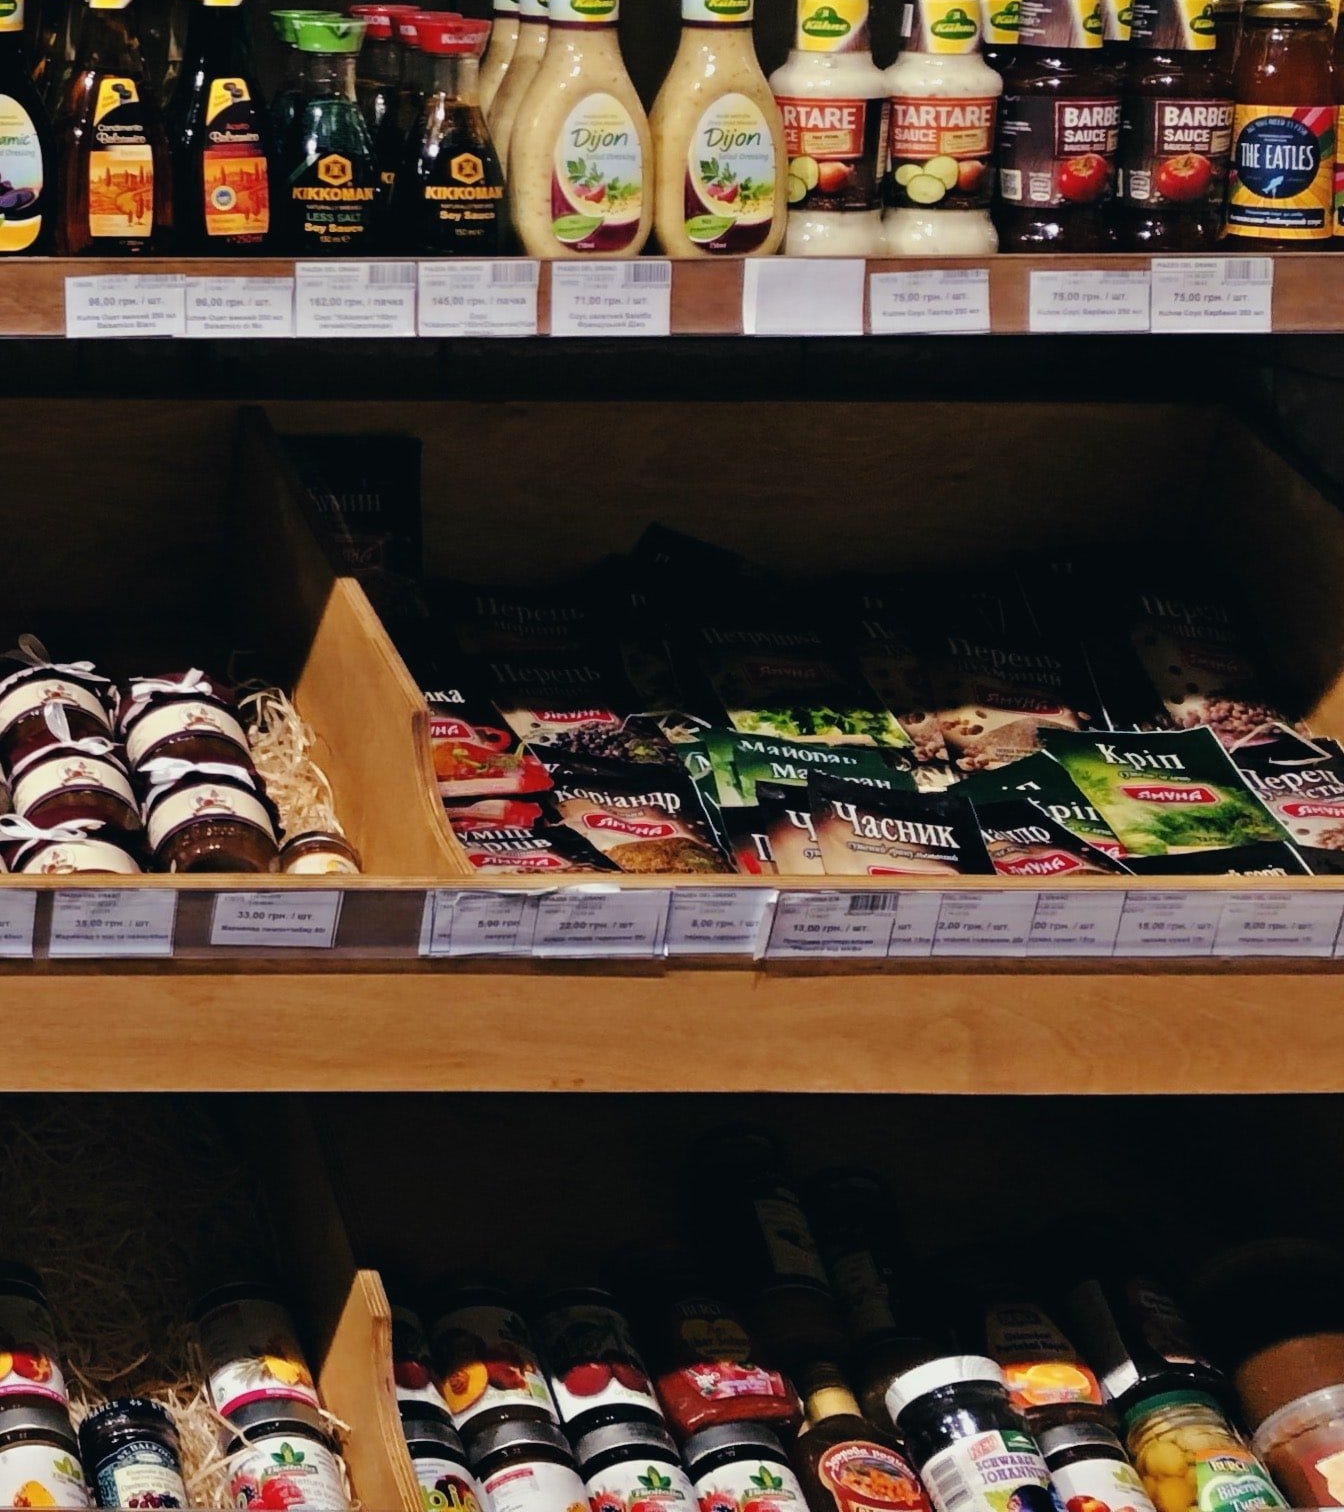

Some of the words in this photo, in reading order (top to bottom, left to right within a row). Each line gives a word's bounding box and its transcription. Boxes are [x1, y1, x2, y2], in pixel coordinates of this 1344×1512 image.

[895, 106, 991, 128] TARTARE
[571, 128, 627, 151] Dijon
[704, 128, 761, 151] Dijon
[895, 130, 936, 143] SAUCE
[1065, 130, 1105, 142] SAUCE
[1164, 130, 1210, 142] SAUCE
[1241, 142, 1260, 168] THE
[1267, 143, 1313, 170] EATLES
[293, 187, 373, 201] KIKKOMAN
[304, 224, 324, 233] Soy
[328, 224, 363, 232] Sauce
[1096, 744, 1185, 770] Кріп
[555, 788, 680, 812] Коріандр
[832, 801, 960, 849] Часник
